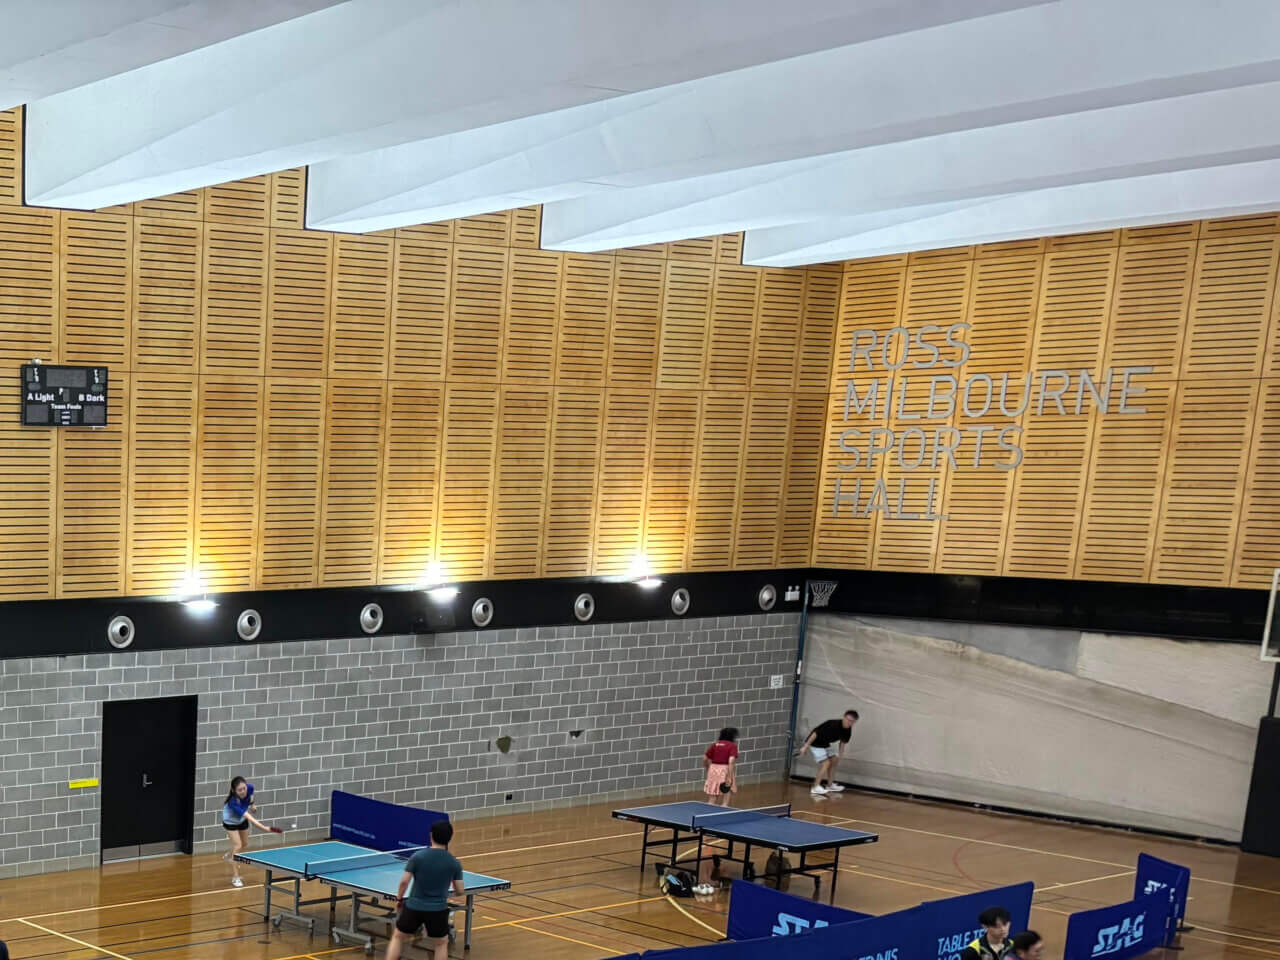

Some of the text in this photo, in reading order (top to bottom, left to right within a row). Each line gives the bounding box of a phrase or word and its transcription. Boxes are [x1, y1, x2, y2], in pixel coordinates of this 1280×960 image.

[849, 322, 971, 371] ROSS
[35, 393, 54, 402] Light
[843, 366, 1153, 421] MILBOURNE
[837, 425, 1024, 471] SPORTS
[832, 478, 950, 521] HALL
[938, 931, 971, 956] TABLE
[1091, 911, 1146, 957] STAG
